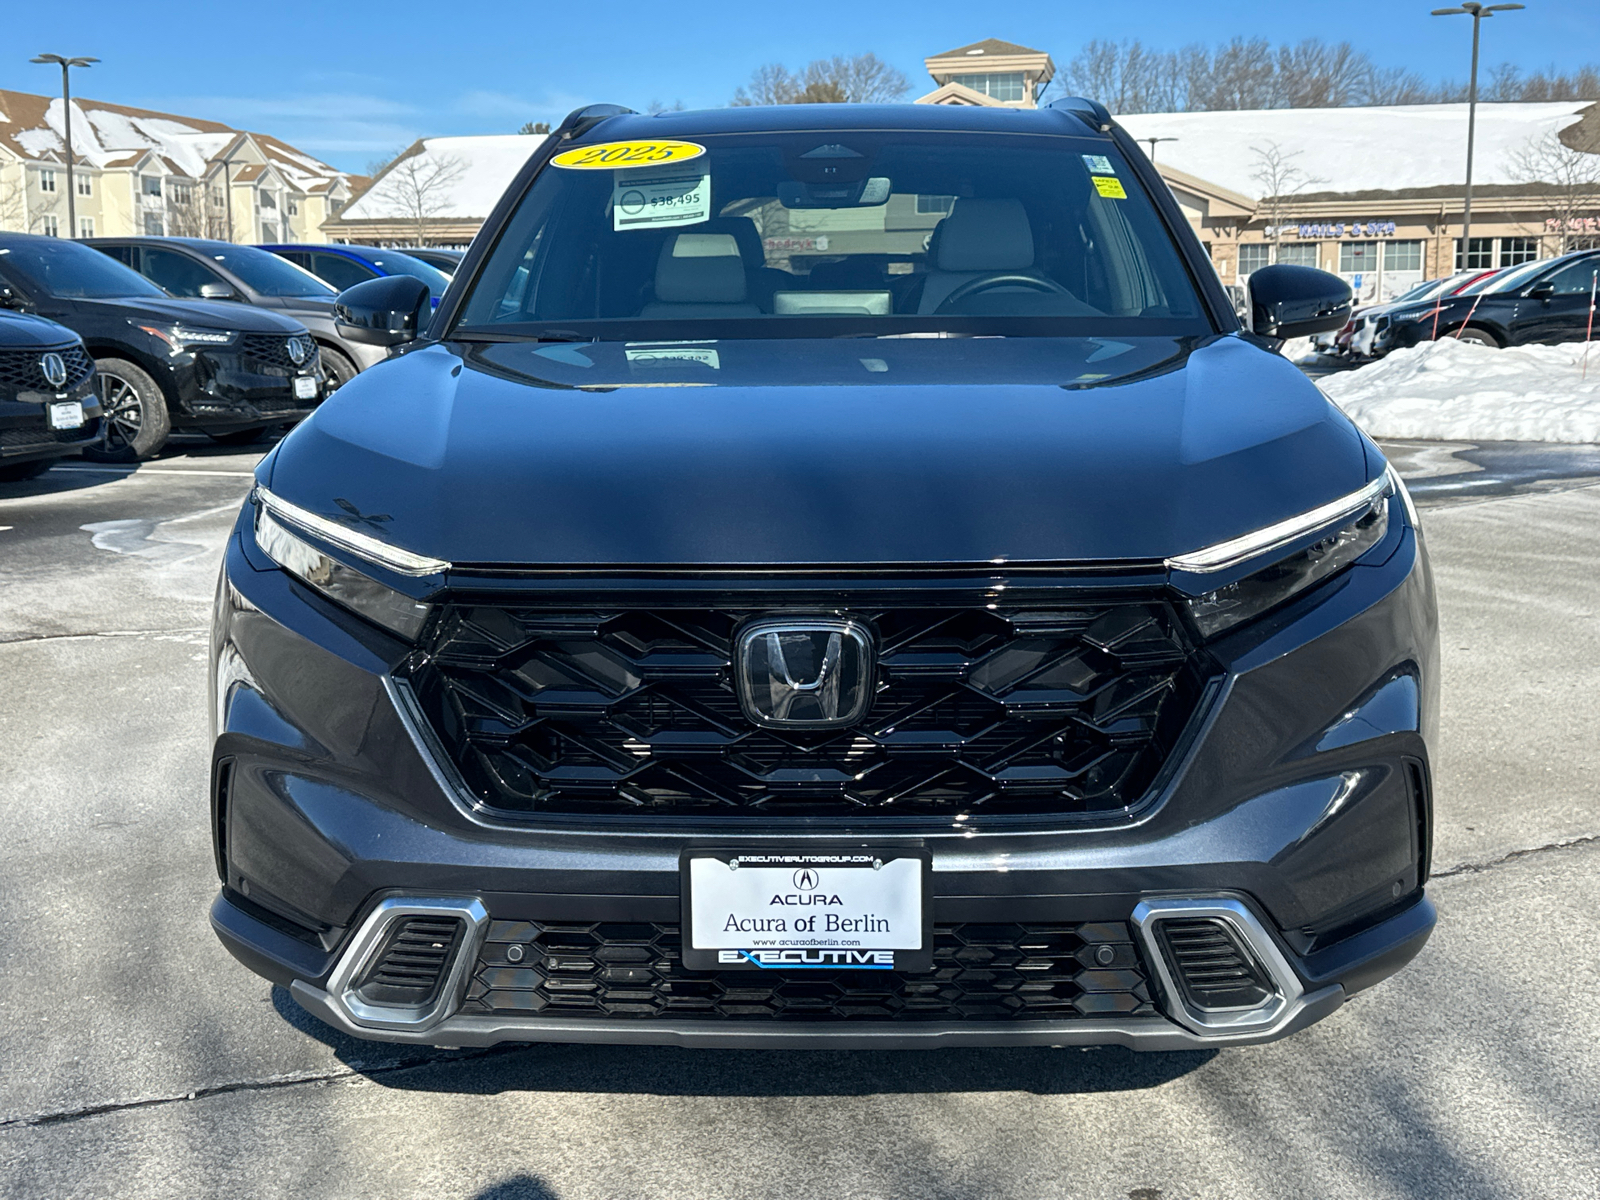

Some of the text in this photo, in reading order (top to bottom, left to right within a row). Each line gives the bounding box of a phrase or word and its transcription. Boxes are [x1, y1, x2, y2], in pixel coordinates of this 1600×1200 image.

[572, 145, 683, 165] 2025
[651, 194, 700, 209] $38,495
[1299, 223, 1345, 236] NAILS
[1352, 222, 1364, 235] &
[1366, 221, 1396, 235] SPA
[738, 855, 874, 863] EXECUTIVEAUTOGROUP.COM
[769, 894, 844, 906] ACURA
[723, 913, 890, 932] Acura of Berlin
[753, 938, 861, 947] www.acuraofberlin.com
[718, 950, 894, 964] EXECUTIVE
